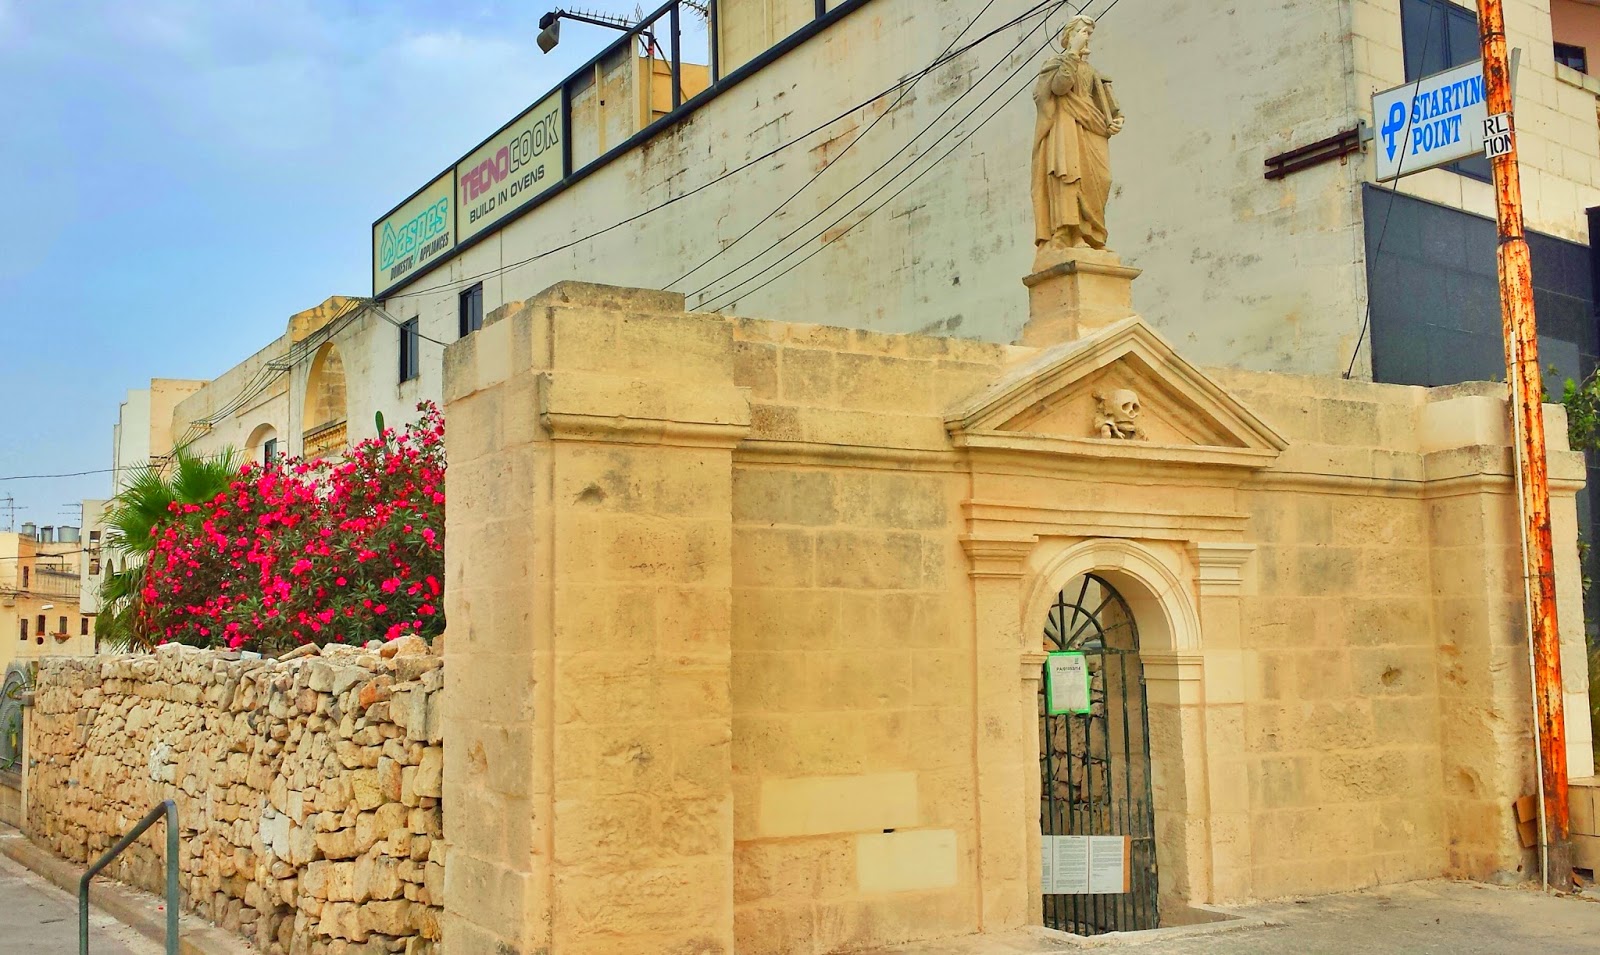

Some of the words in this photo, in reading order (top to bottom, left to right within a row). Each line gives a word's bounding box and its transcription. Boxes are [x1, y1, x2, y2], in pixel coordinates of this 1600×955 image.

[1412, 114, 1462, 155] POINT
[1483, 116, 1508, 136] RL
[460, 108, 559, 206] TECNOCOOK
[470, 197, 495, 224] BUILD
[498, 188, 508, 206] IN
[510, 164, 545, 198] OVENS
[390, 254, 414, 281] DOMESTIC
[419, 231, 449, 263] APPLIANCES
